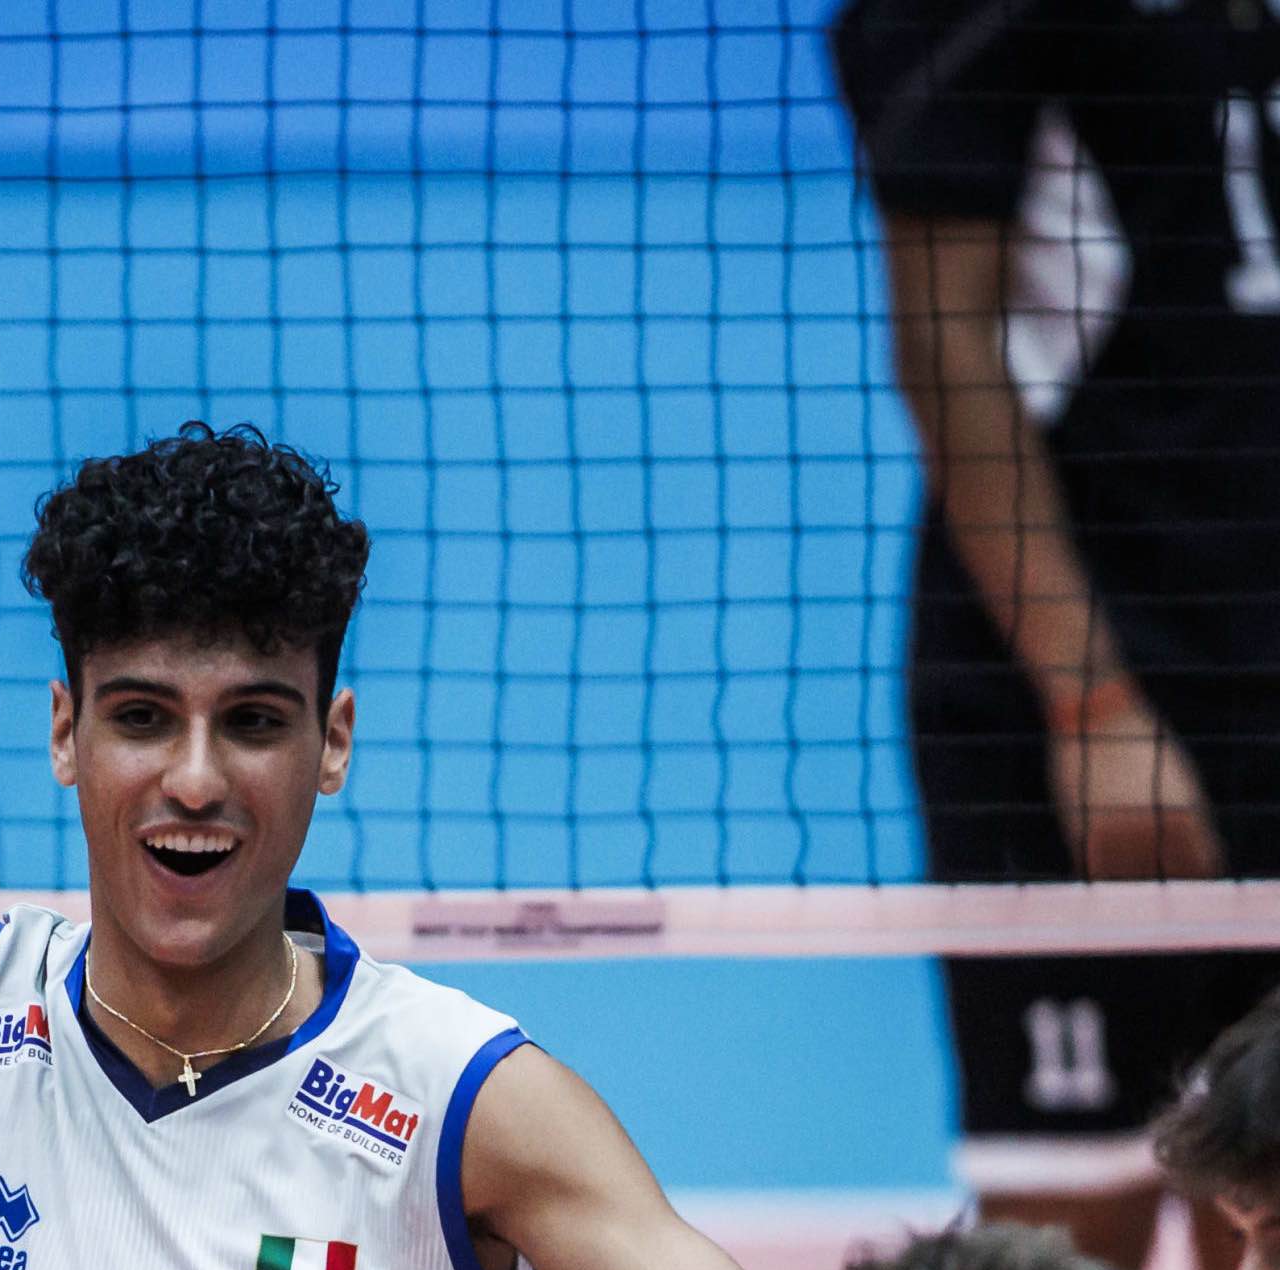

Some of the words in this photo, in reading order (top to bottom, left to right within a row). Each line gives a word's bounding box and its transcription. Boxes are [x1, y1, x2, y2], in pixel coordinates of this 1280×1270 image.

[287, 1101, 326, 1130] HOME
[327, 1123, 344, 1135] OF
[343, 1128, 404, 1166] BUILDERS
[300, 1057, 419, 1142] BigMat
